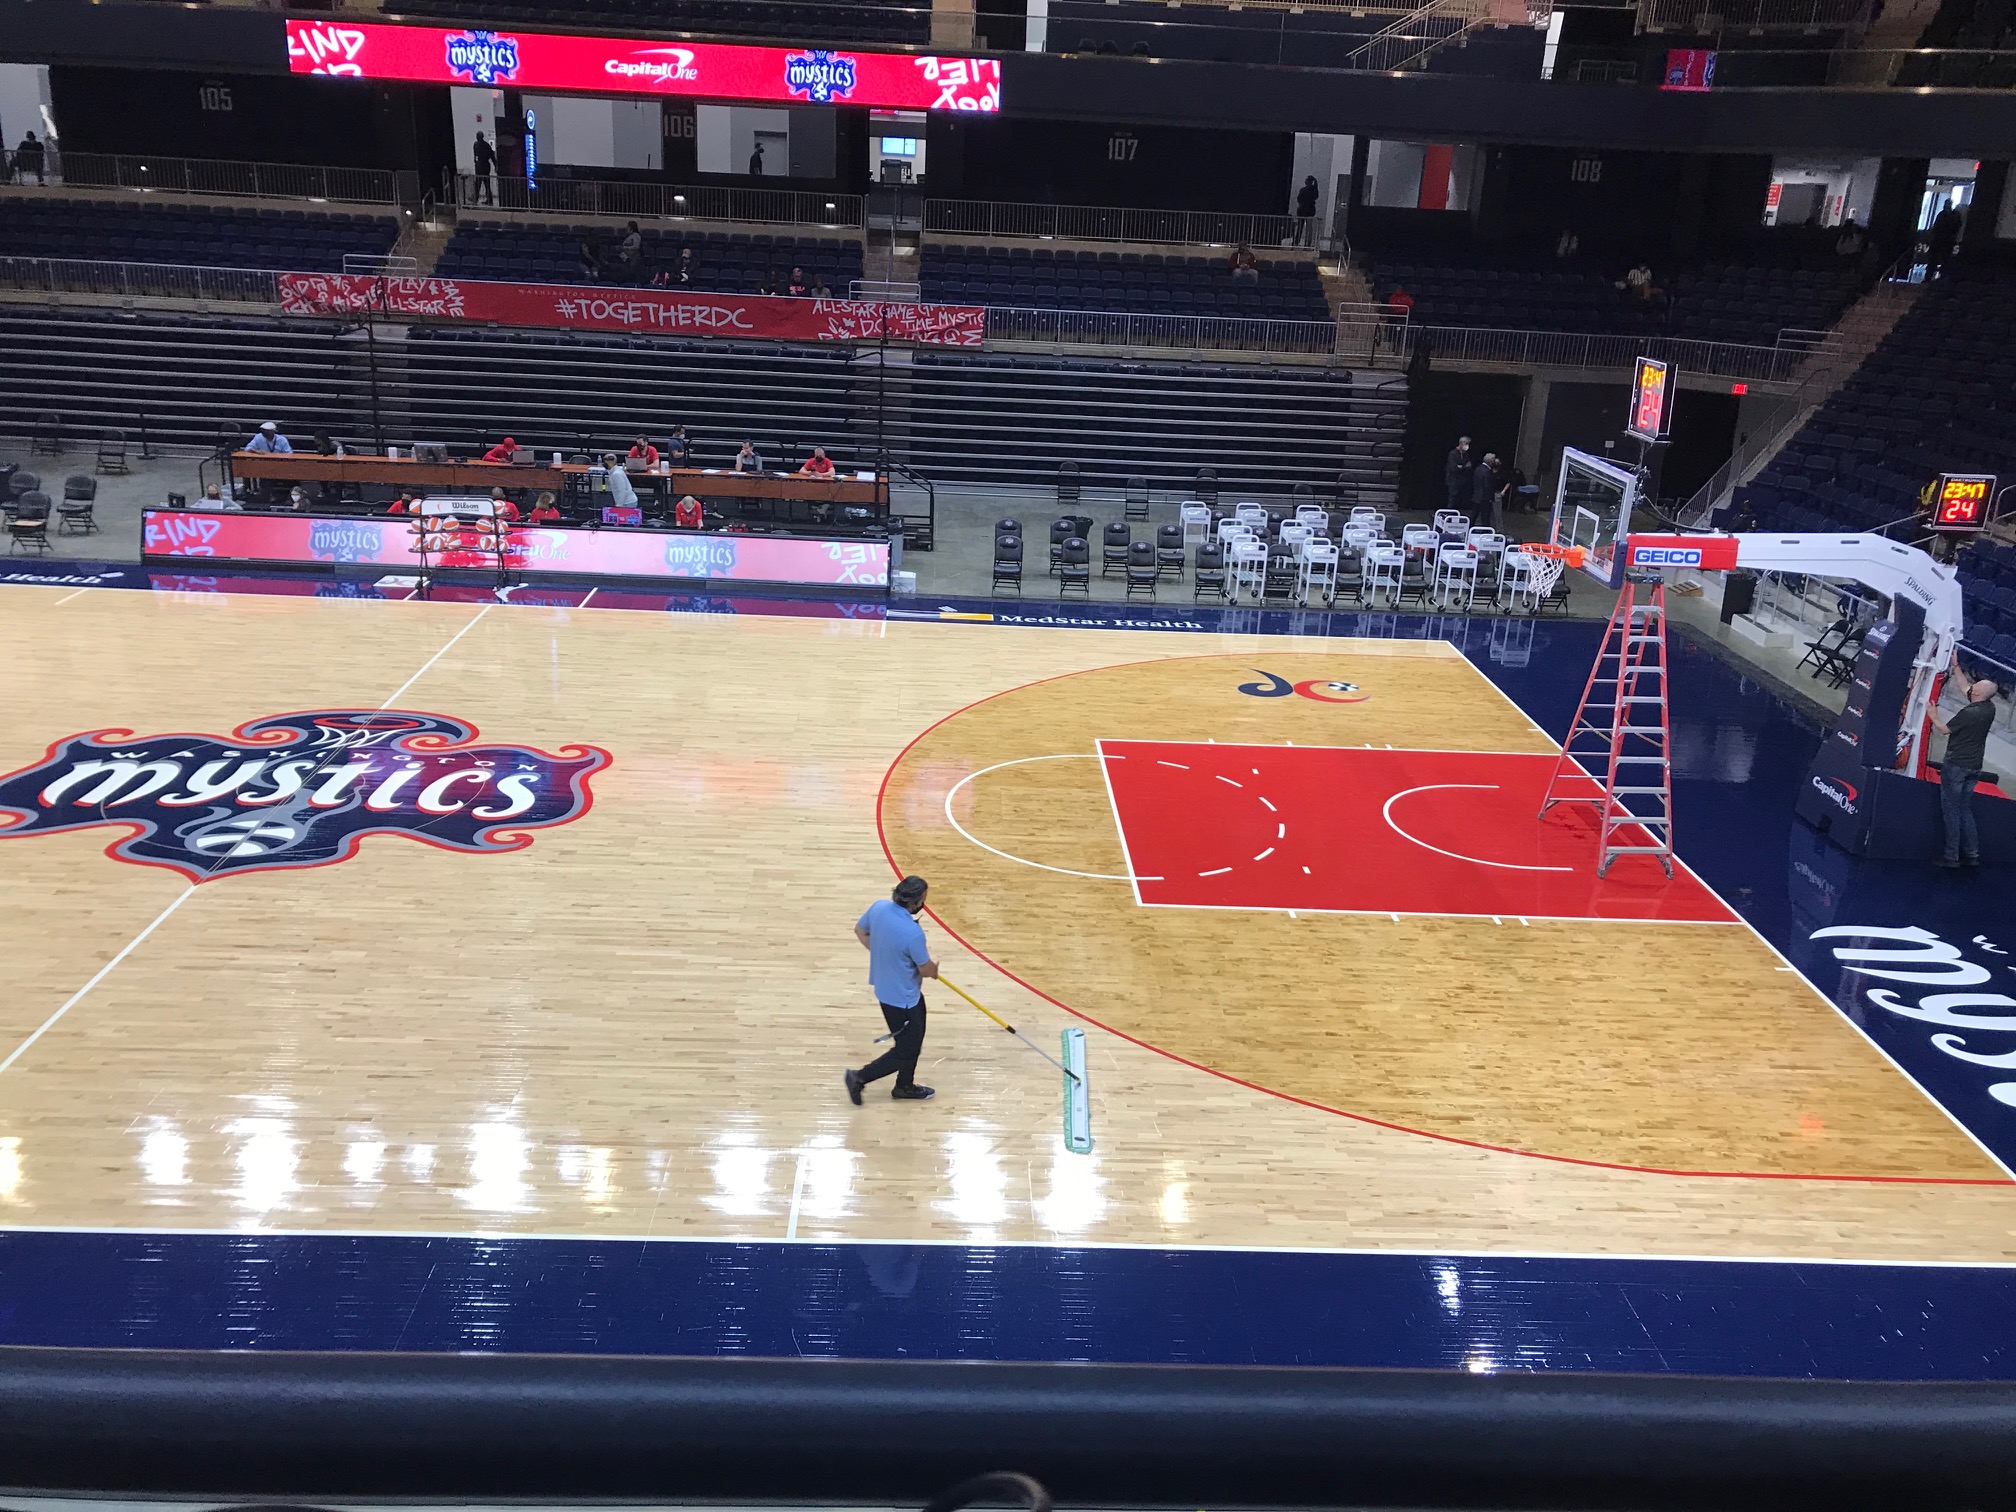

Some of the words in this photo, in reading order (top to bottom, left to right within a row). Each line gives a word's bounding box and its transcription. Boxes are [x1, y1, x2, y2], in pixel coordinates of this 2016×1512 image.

[451, 43, 515, 69] mystics
[790, 63, 853, 87] mystics
[199, 86, 233, 111] 105
[664, 114, 695, 138] 106
[1107, 137, 1139, 162] 107
[1571, 159, 1603, 183] 108
[554, 298, 753, 329] #TOGETHERDC
[812, 299, 878, 318] ALL-STAR
[1642, 365, 1666, 389] 23:4
[1639, 388, 1661, 429] 24
[1943, 482, 1986, 499] 23:47
[451, 501, 479, 510] Wilson
[1945, 499, 1975, 519] 24
[314, 530, 380, 551] mystics
[668, 543, 734, 567] mystics
[1635, 549, 1701, 566] GEICO
[1, 573, 103, 584] Health
[1903, 576, 1937, 606] SPALDING
[1000, 615, 1108, 626] MedStar
[1113, 619, 1204, 629] Health
[111, 750, 540, 772] WASHINGTON
[41, 757, 541, 819] mystics
